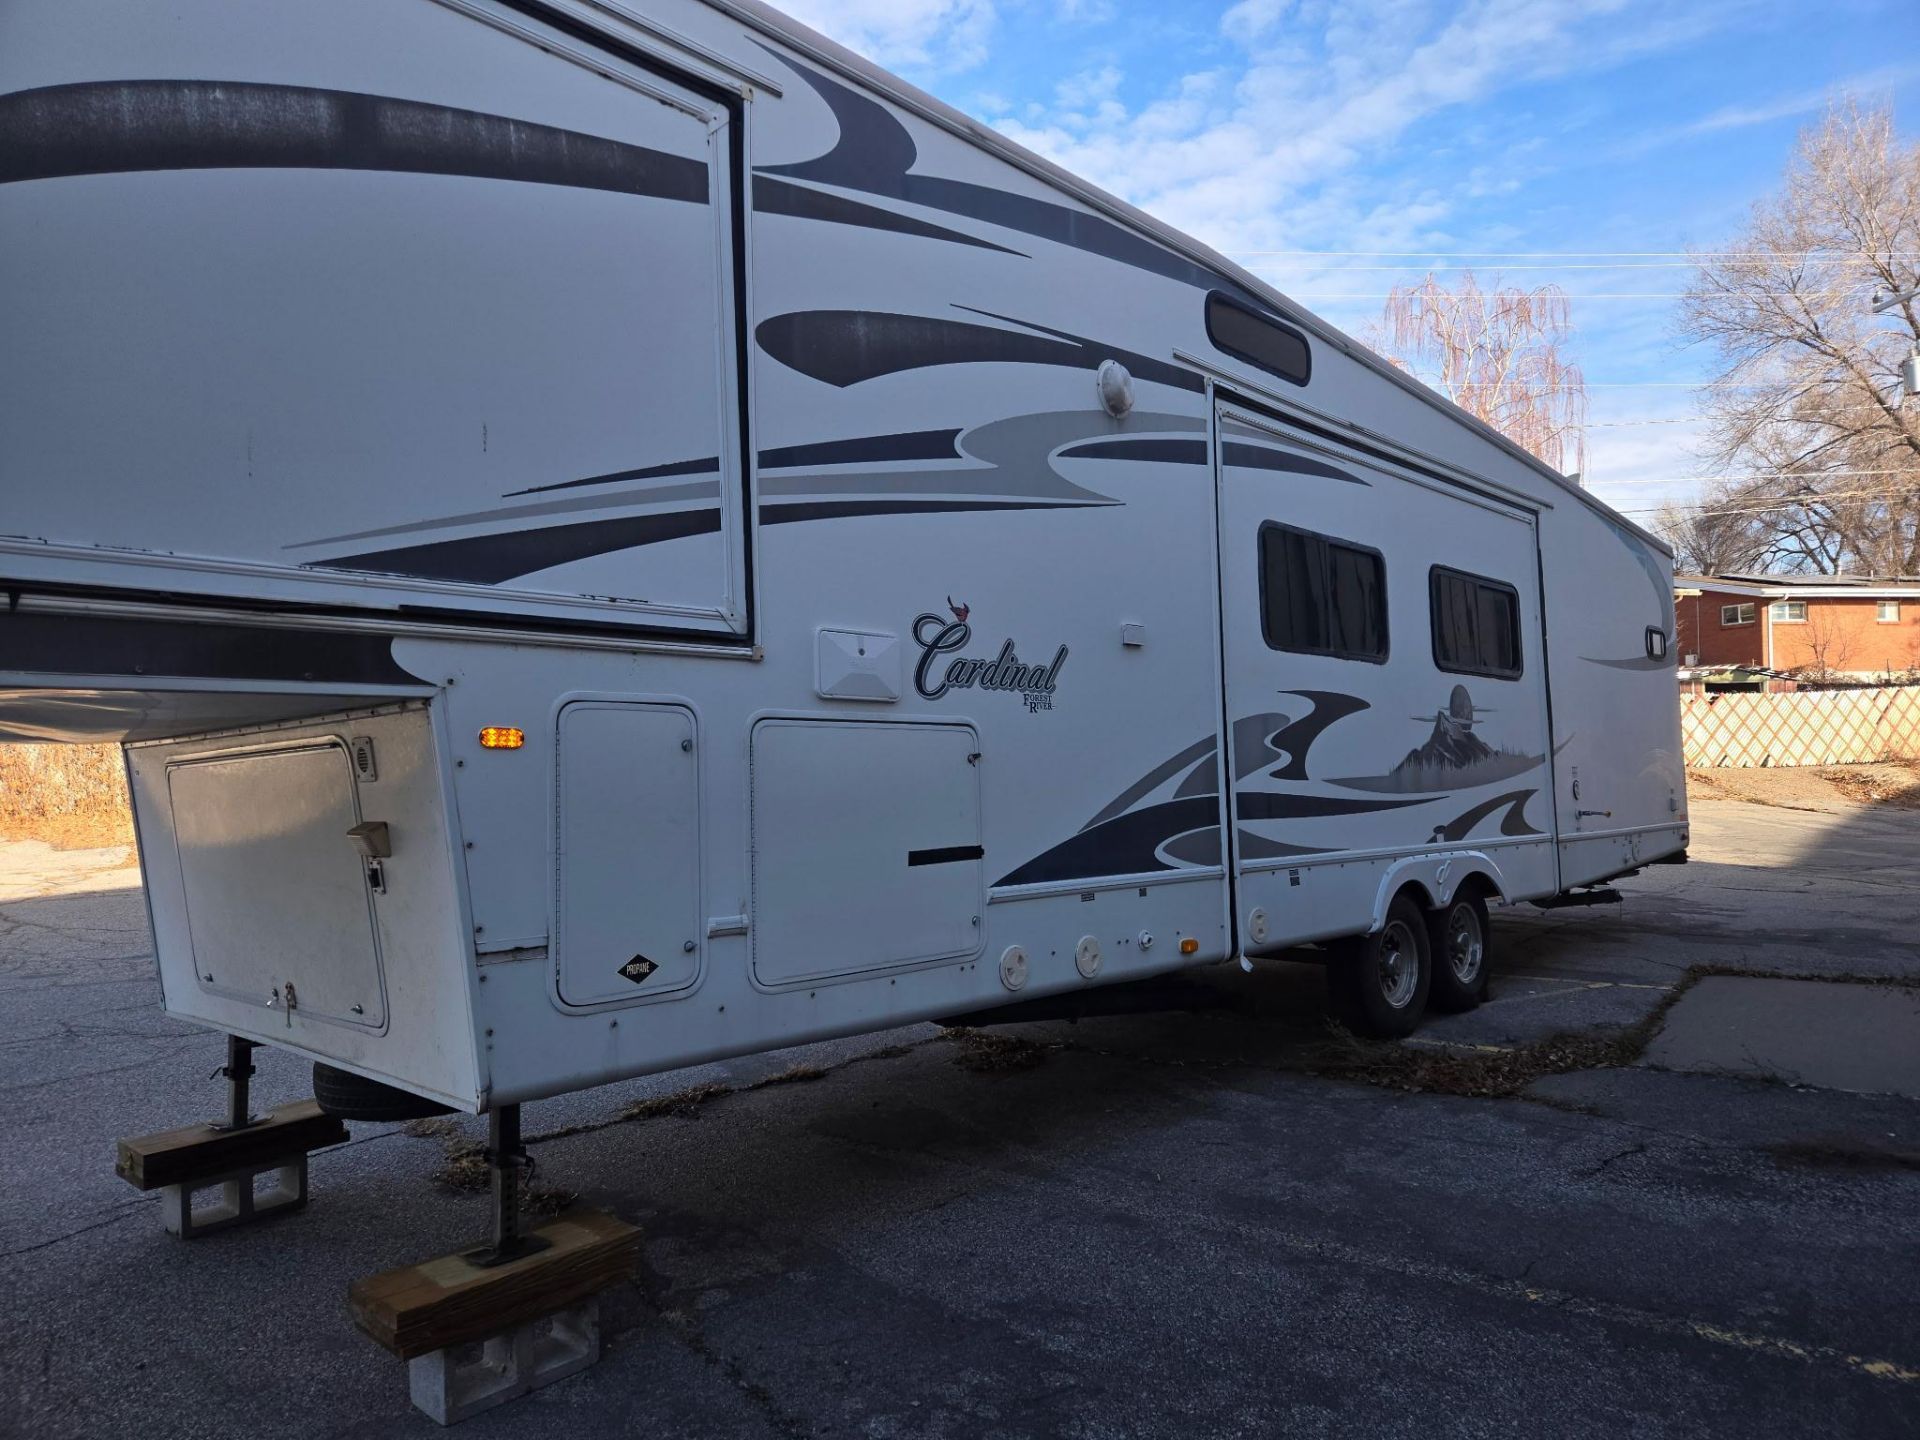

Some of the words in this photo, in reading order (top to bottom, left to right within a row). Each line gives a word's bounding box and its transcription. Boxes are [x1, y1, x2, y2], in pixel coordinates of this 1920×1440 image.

[912, 613, 1068, 700] Cardinal
[1023, 693, 1052, 706] FOREST
[626, 962, 650, 975] PROPANE
